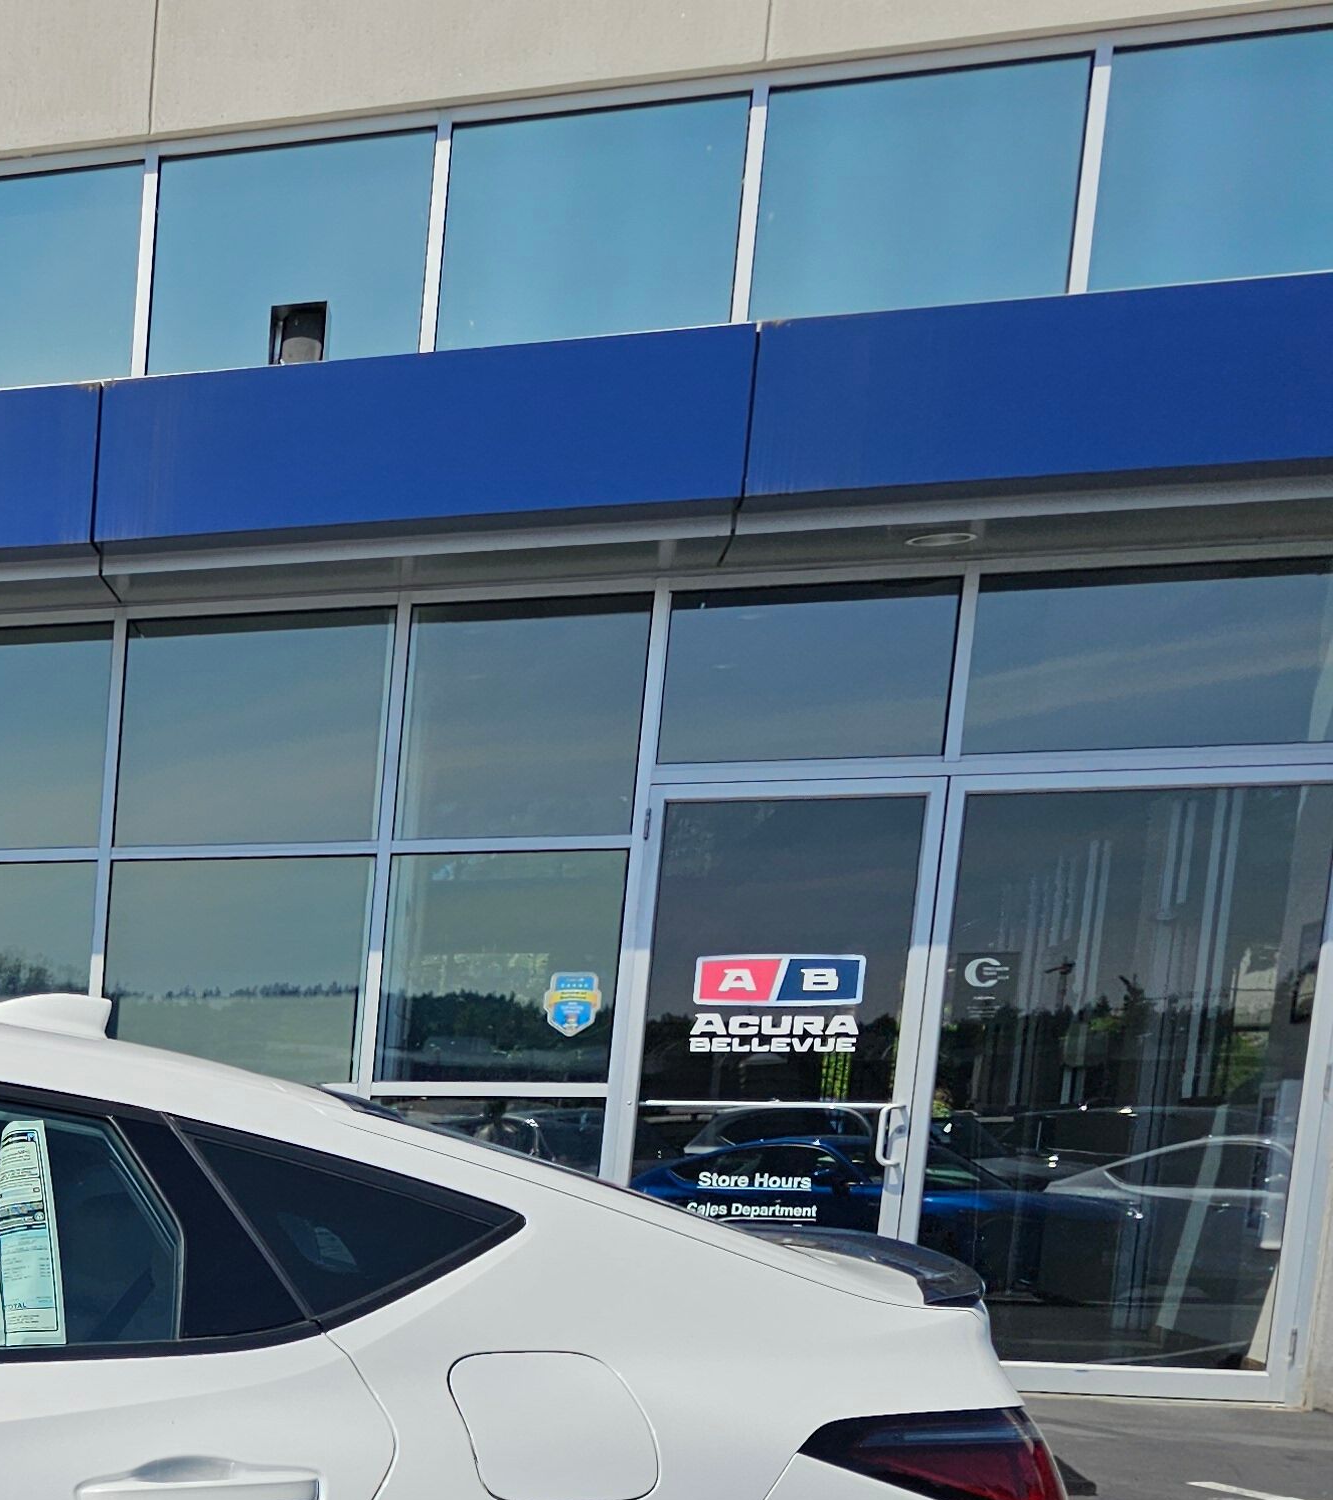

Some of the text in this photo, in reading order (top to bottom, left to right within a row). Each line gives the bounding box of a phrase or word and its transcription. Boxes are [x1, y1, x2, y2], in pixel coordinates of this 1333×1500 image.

[718, 968, 839, 992] A B
[689, 1013, 859, 1036] ACURA
[688, 1037, 857, 1053] BELLEVUE
[697, 1171, 812, 1189] Store Hours
[731, 1203, 818, 1217] Department
